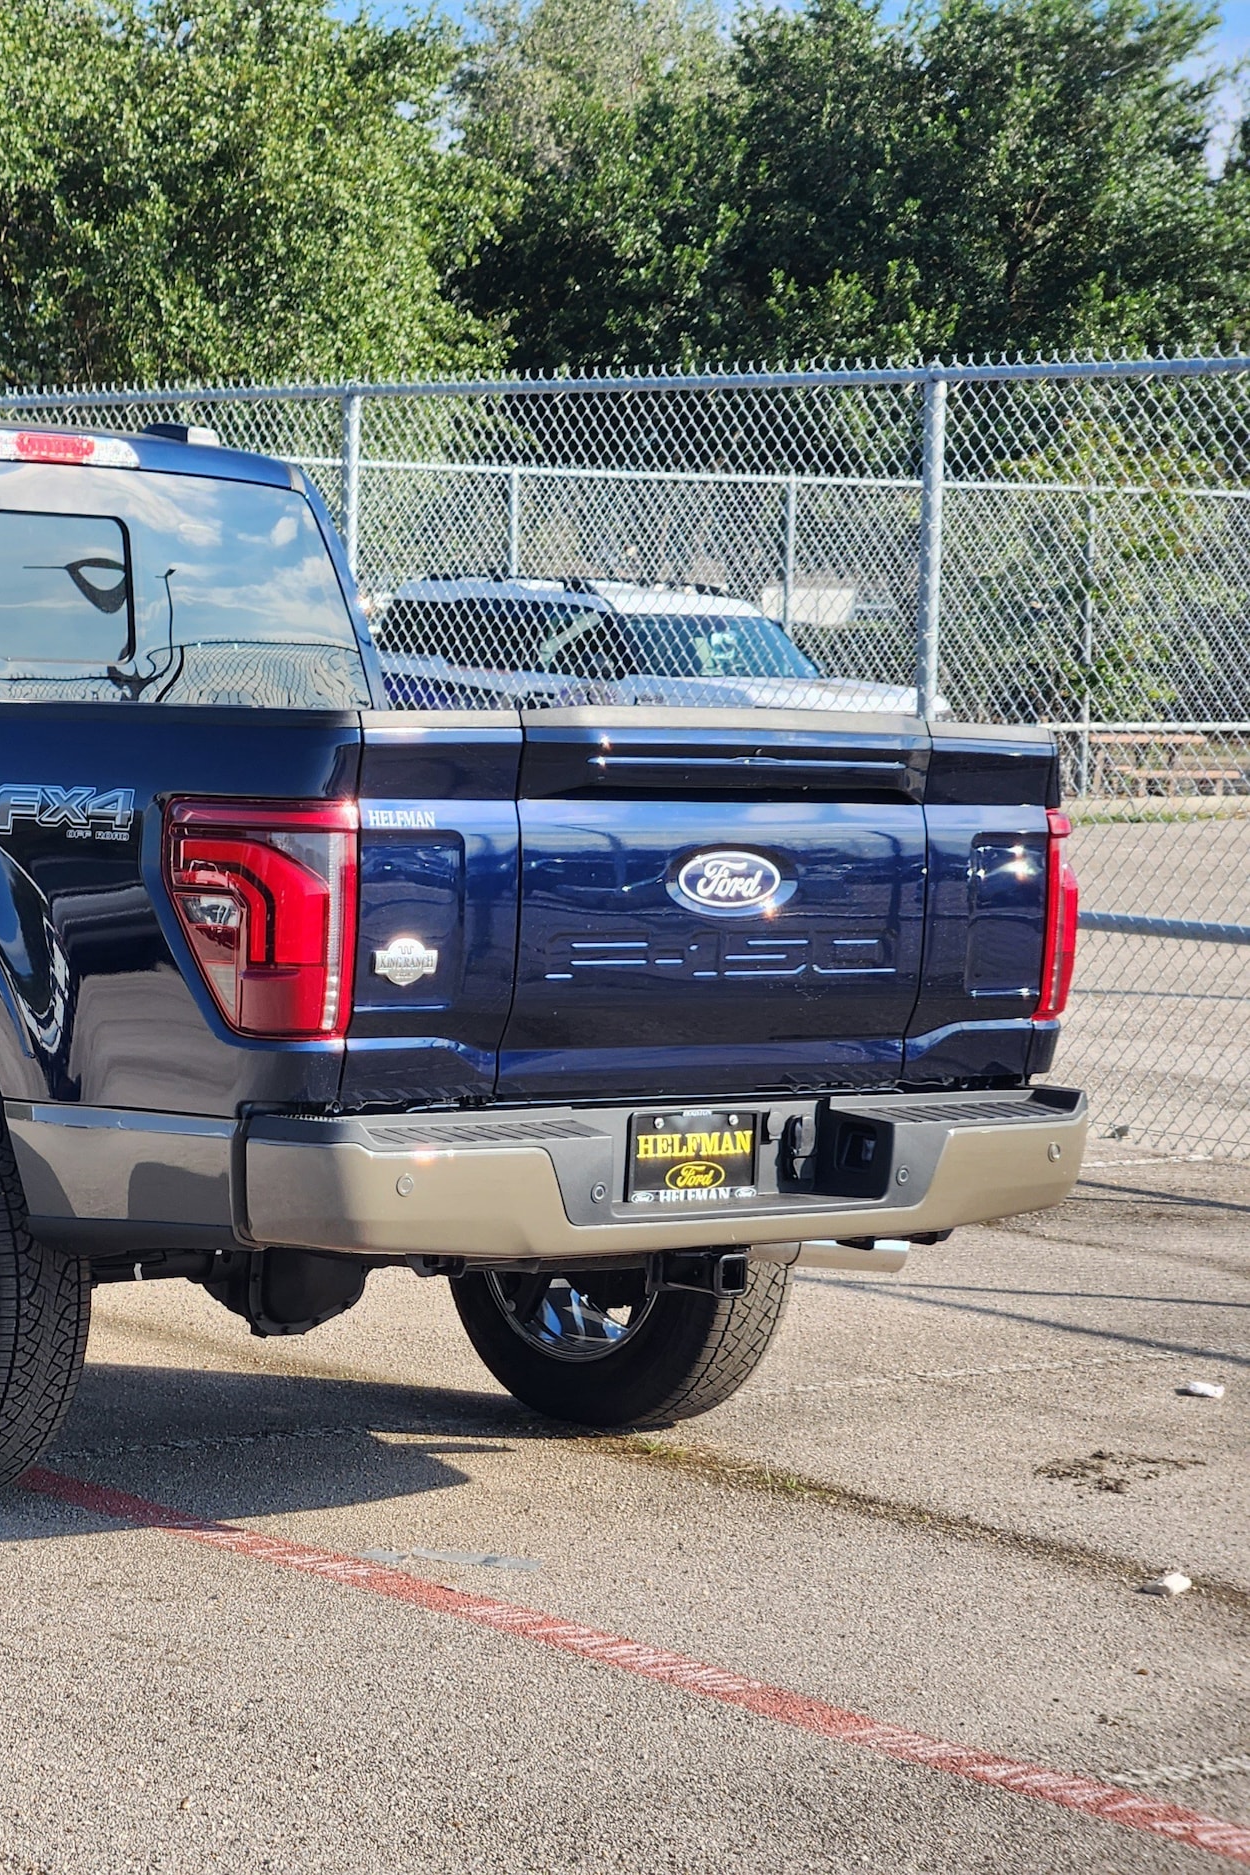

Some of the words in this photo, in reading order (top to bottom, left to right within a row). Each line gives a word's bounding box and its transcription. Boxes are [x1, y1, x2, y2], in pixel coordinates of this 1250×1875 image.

[368, 810, 435, 827] HELFMAN
[66, 829, 92, 839] OFF
[95, 831, 129, 841] ROAD
[697, 860, 763, 897] Ford
[380, 955, 402, 968] KING
[545, 930, 900, 979] F-150
[636, 1130, 753, 1158] HELFMAN
[676, 1165, 715, 1187] Ford
